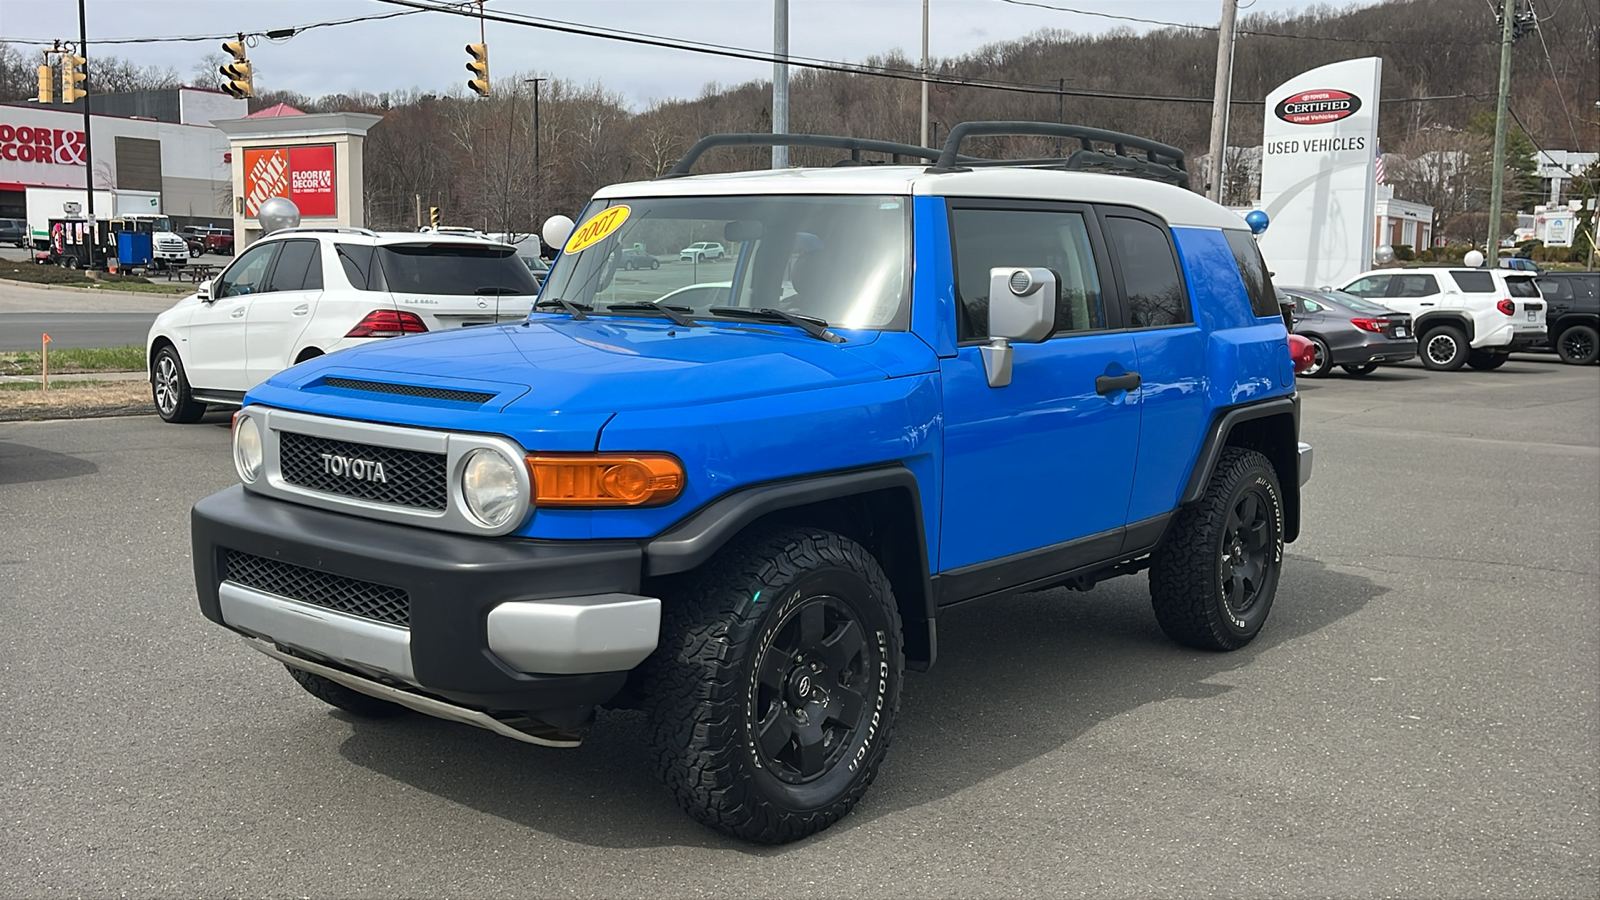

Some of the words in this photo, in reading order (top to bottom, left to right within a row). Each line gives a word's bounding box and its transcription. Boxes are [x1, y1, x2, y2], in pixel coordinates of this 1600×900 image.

[1311, 113, 1339, 121] Vehicles
[0, 143, 53, 164] COR
[1267, 140, 1299, 155] USED
[1303, 136, 1365, 153] VEHICLES
[248, 154, 268, 183] THE
[292, 171, 318, 180] FLOOR
[246, 149, 287, 217] HOME
[292, 179, 319, 188] DECOR
[572, 209, 620, 250] 2007
[321, 453, 388, 483] TOYOTA
